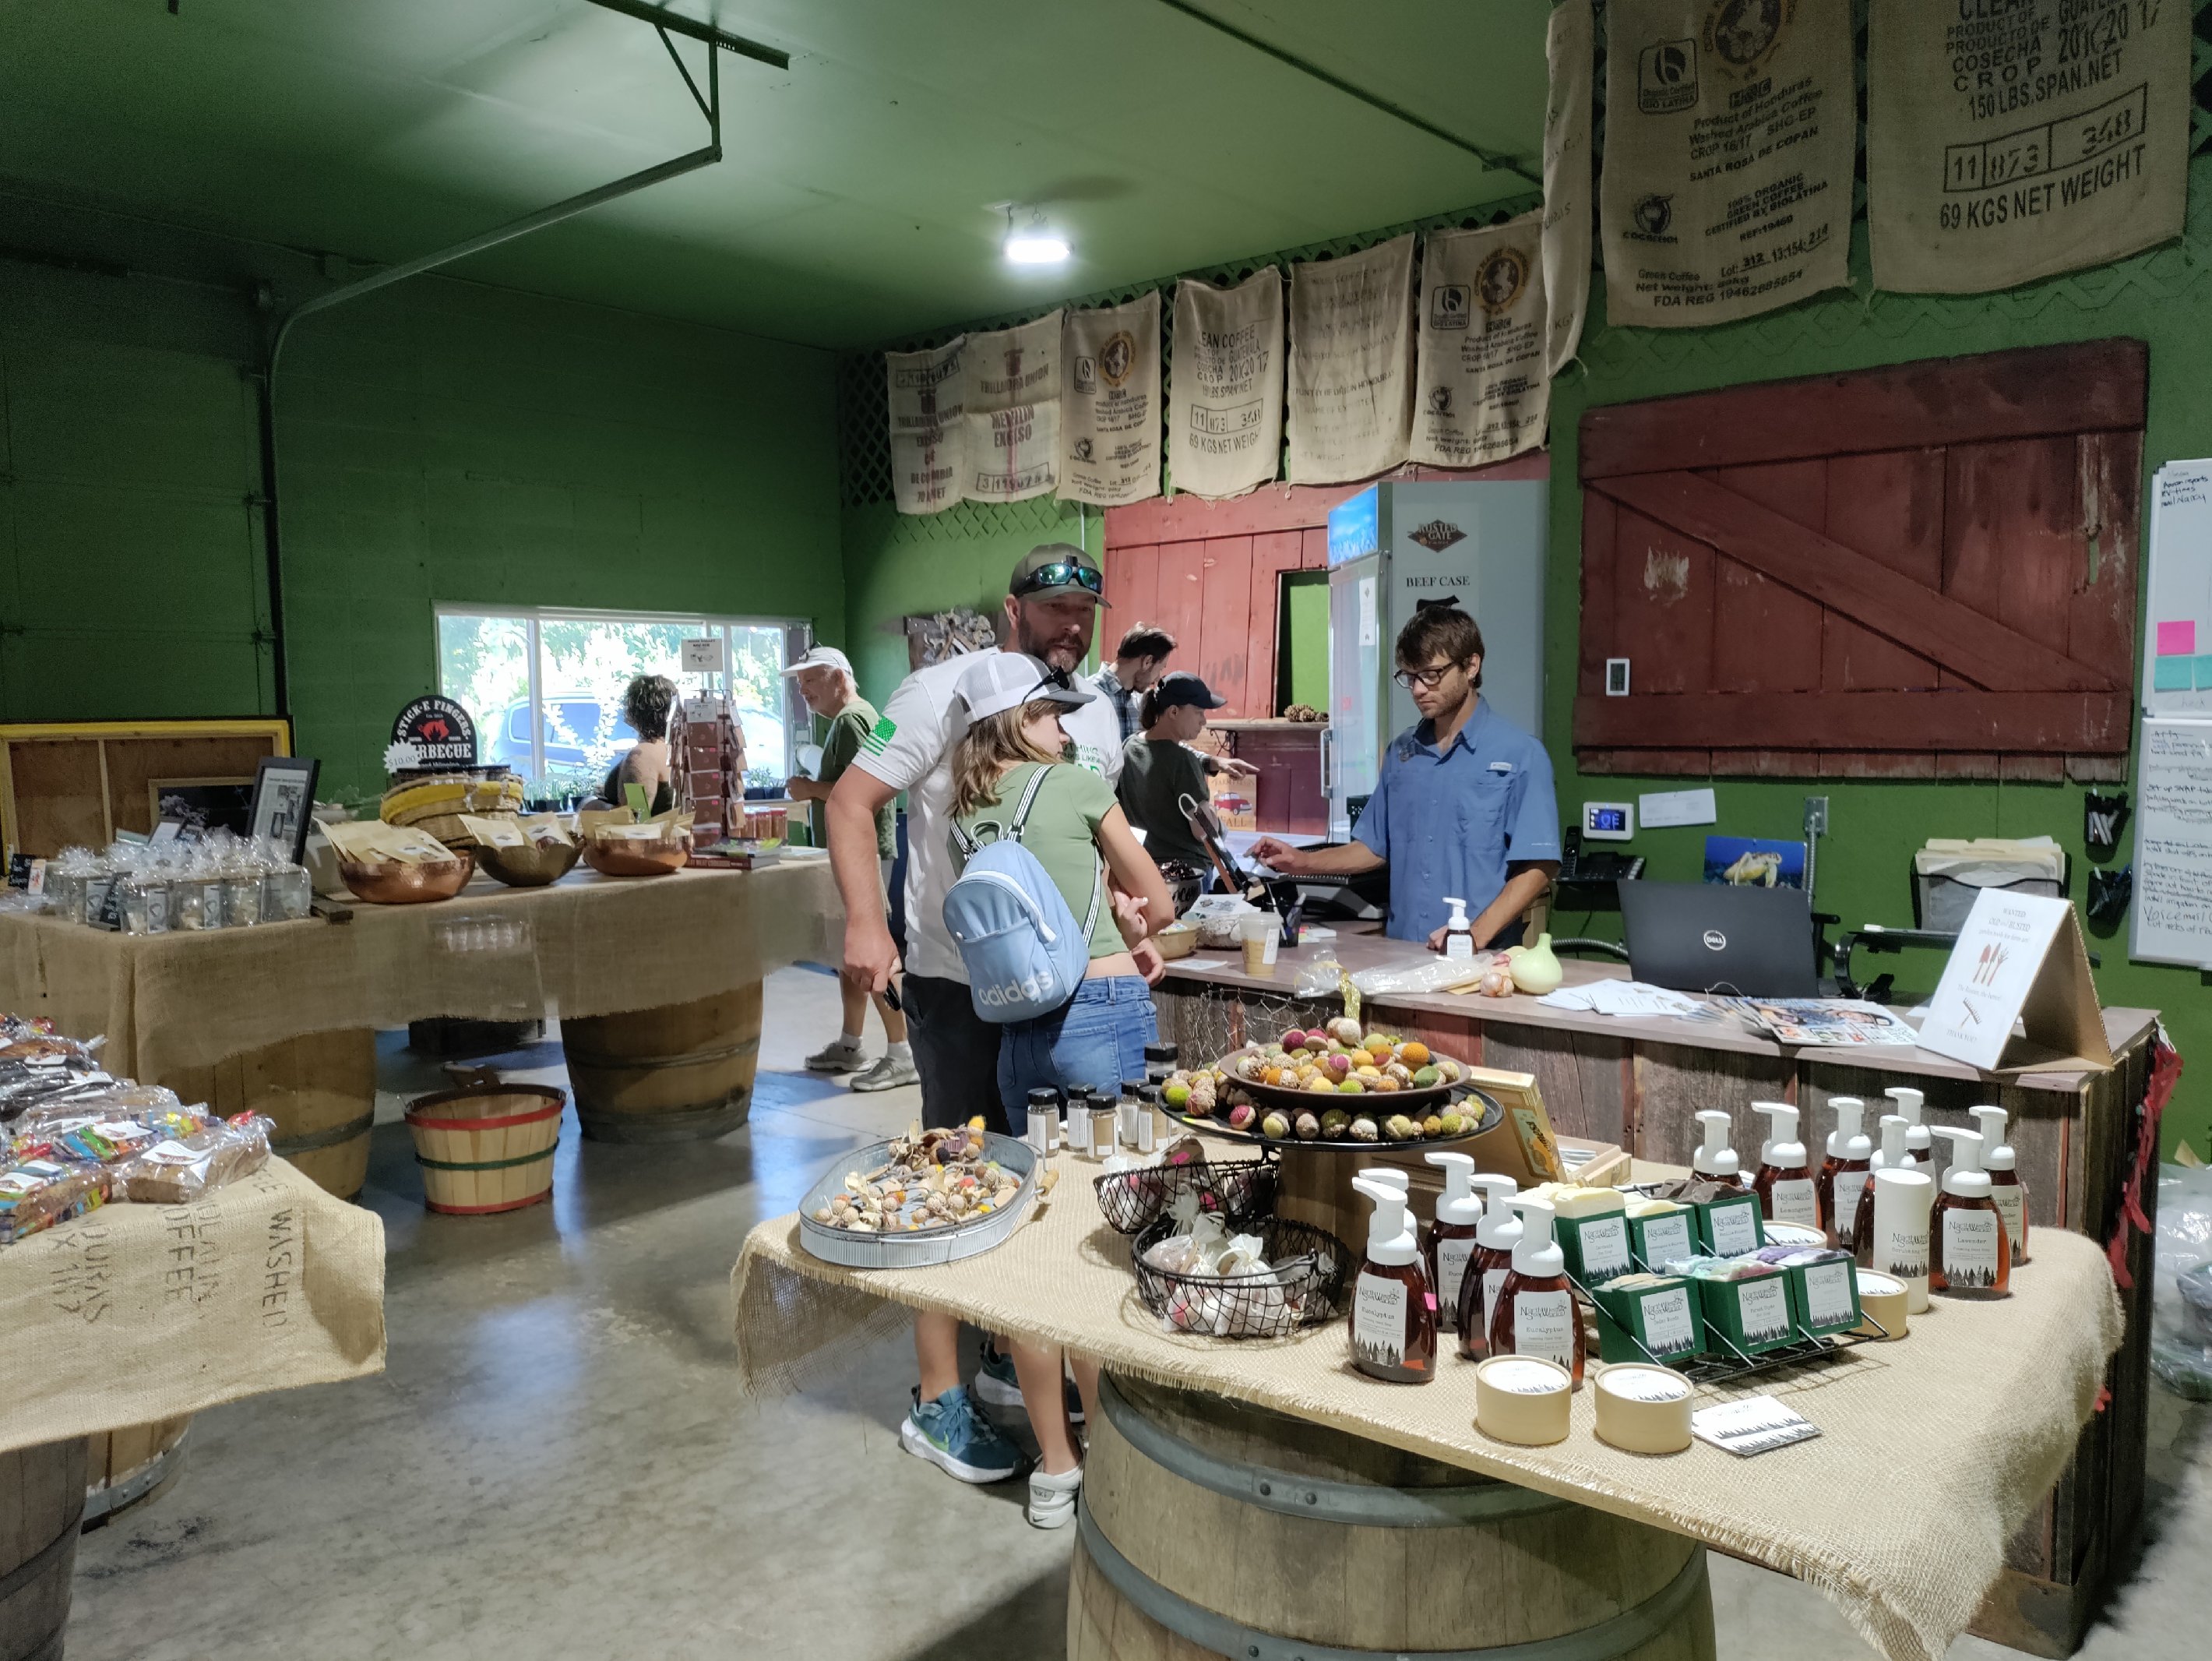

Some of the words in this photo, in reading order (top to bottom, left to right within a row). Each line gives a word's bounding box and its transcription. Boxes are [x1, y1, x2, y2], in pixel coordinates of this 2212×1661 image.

[1953, 37, 2041, 74] COSECHA
[1694, 114, 1739, 129] Product
[1756, 77, 1812, 114] Honduras
[1970, 95, 1995, 121] 150
[1689, 129, 1734, 145] Washed
[1737, 110, 1777, 135] Arabica
[1781, 89, 1823, 113] Coffee
[1689, 165, 1722, 182] SANTA
[1724, 154, 1755, 173] ROSA
[1758, 145, 1773, 159] DE
[1776, 126, 1819, 151] COPAN
[1690, 143, 1720, 160] CROP
[1954, 155, 1976, 182] 11
[1754, 173, 1804, 199] ORGANIC
[1939, 203, 1960, 229] 69
[1967, 195, 2008, 229] KGS
[2014, 182, 2055, 220] NET
[2061, 143, 2146, 207] WEIGHT
[1654, 295, 1681, 307] FDA
[1685, 293, 1715, 305] REG
[1222, 324, 1255, 348] COFFEE
[1465, 336, 1492, 344] Product
[1025, 363, 1049, 387] UNION
[1196, 411, 1204, 427] 11
[1189, 432, 1199, 449] 69
[1201, 436, 1217, 454] KGS
[1218, 438, 1231, 454] NET
[1418, 523, 1458, 534] RUSTED
[1428, 531, 1453, 541] GATE
[1407, 577, 1437, 588] BEEF
[1439, 574, 1471, 587] CASE
[414, 743, 472, 760] RBECUE
[1988, 917, 2001, 926] OLD
[2008, 922, 2031, 933] RUSTED
[1706, 935, 1724, 946] DELL
[977, 971, 1055, 1007] adidas
[1780, 1206, 1812, 1215] Lemongrass
[261, 1208, 294, 1328] WASHED
[1361, 1306, 1395, 1320] Eucalyptus
